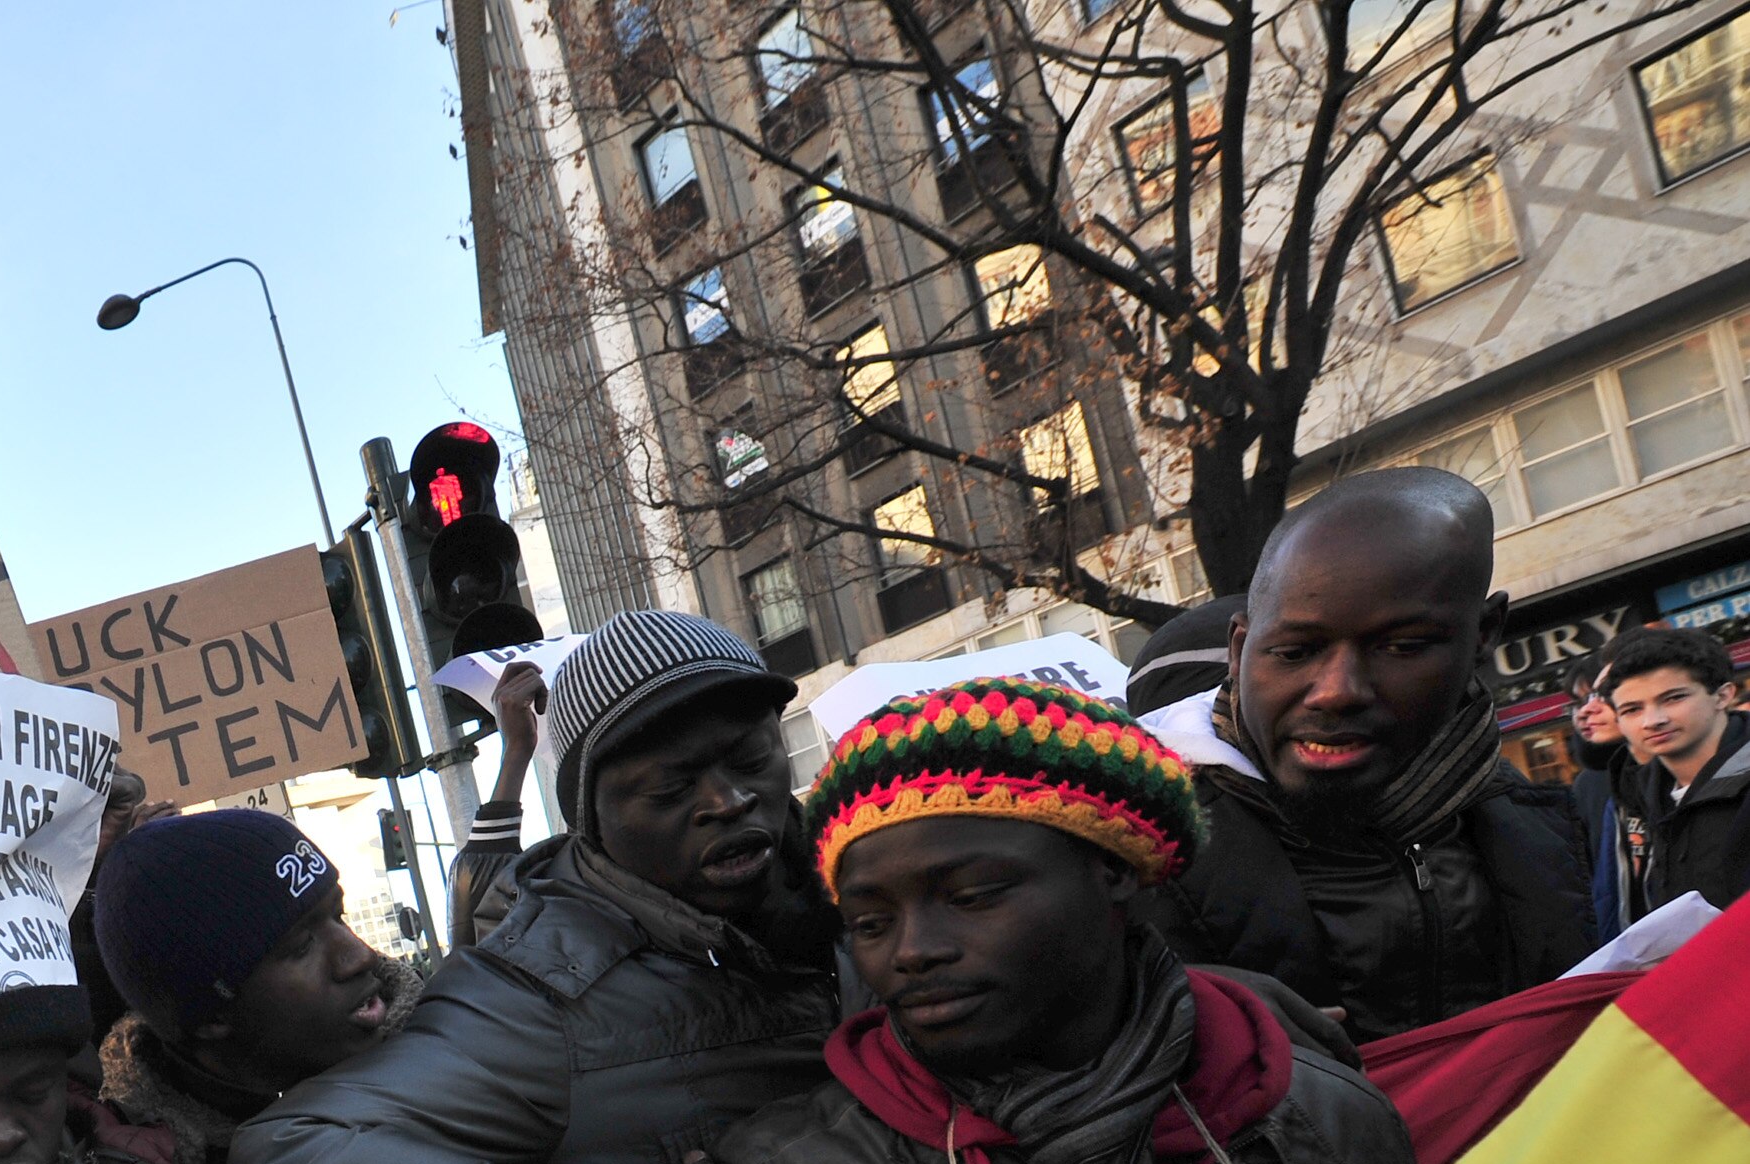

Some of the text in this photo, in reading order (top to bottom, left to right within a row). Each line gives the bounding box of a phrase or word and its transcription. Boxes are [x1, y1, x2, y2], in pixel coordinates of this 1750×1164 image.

[58, 621, 295, 733] YLON
[147, 676, 358, 787] TEM
[276, 839, 327, 898] 23
